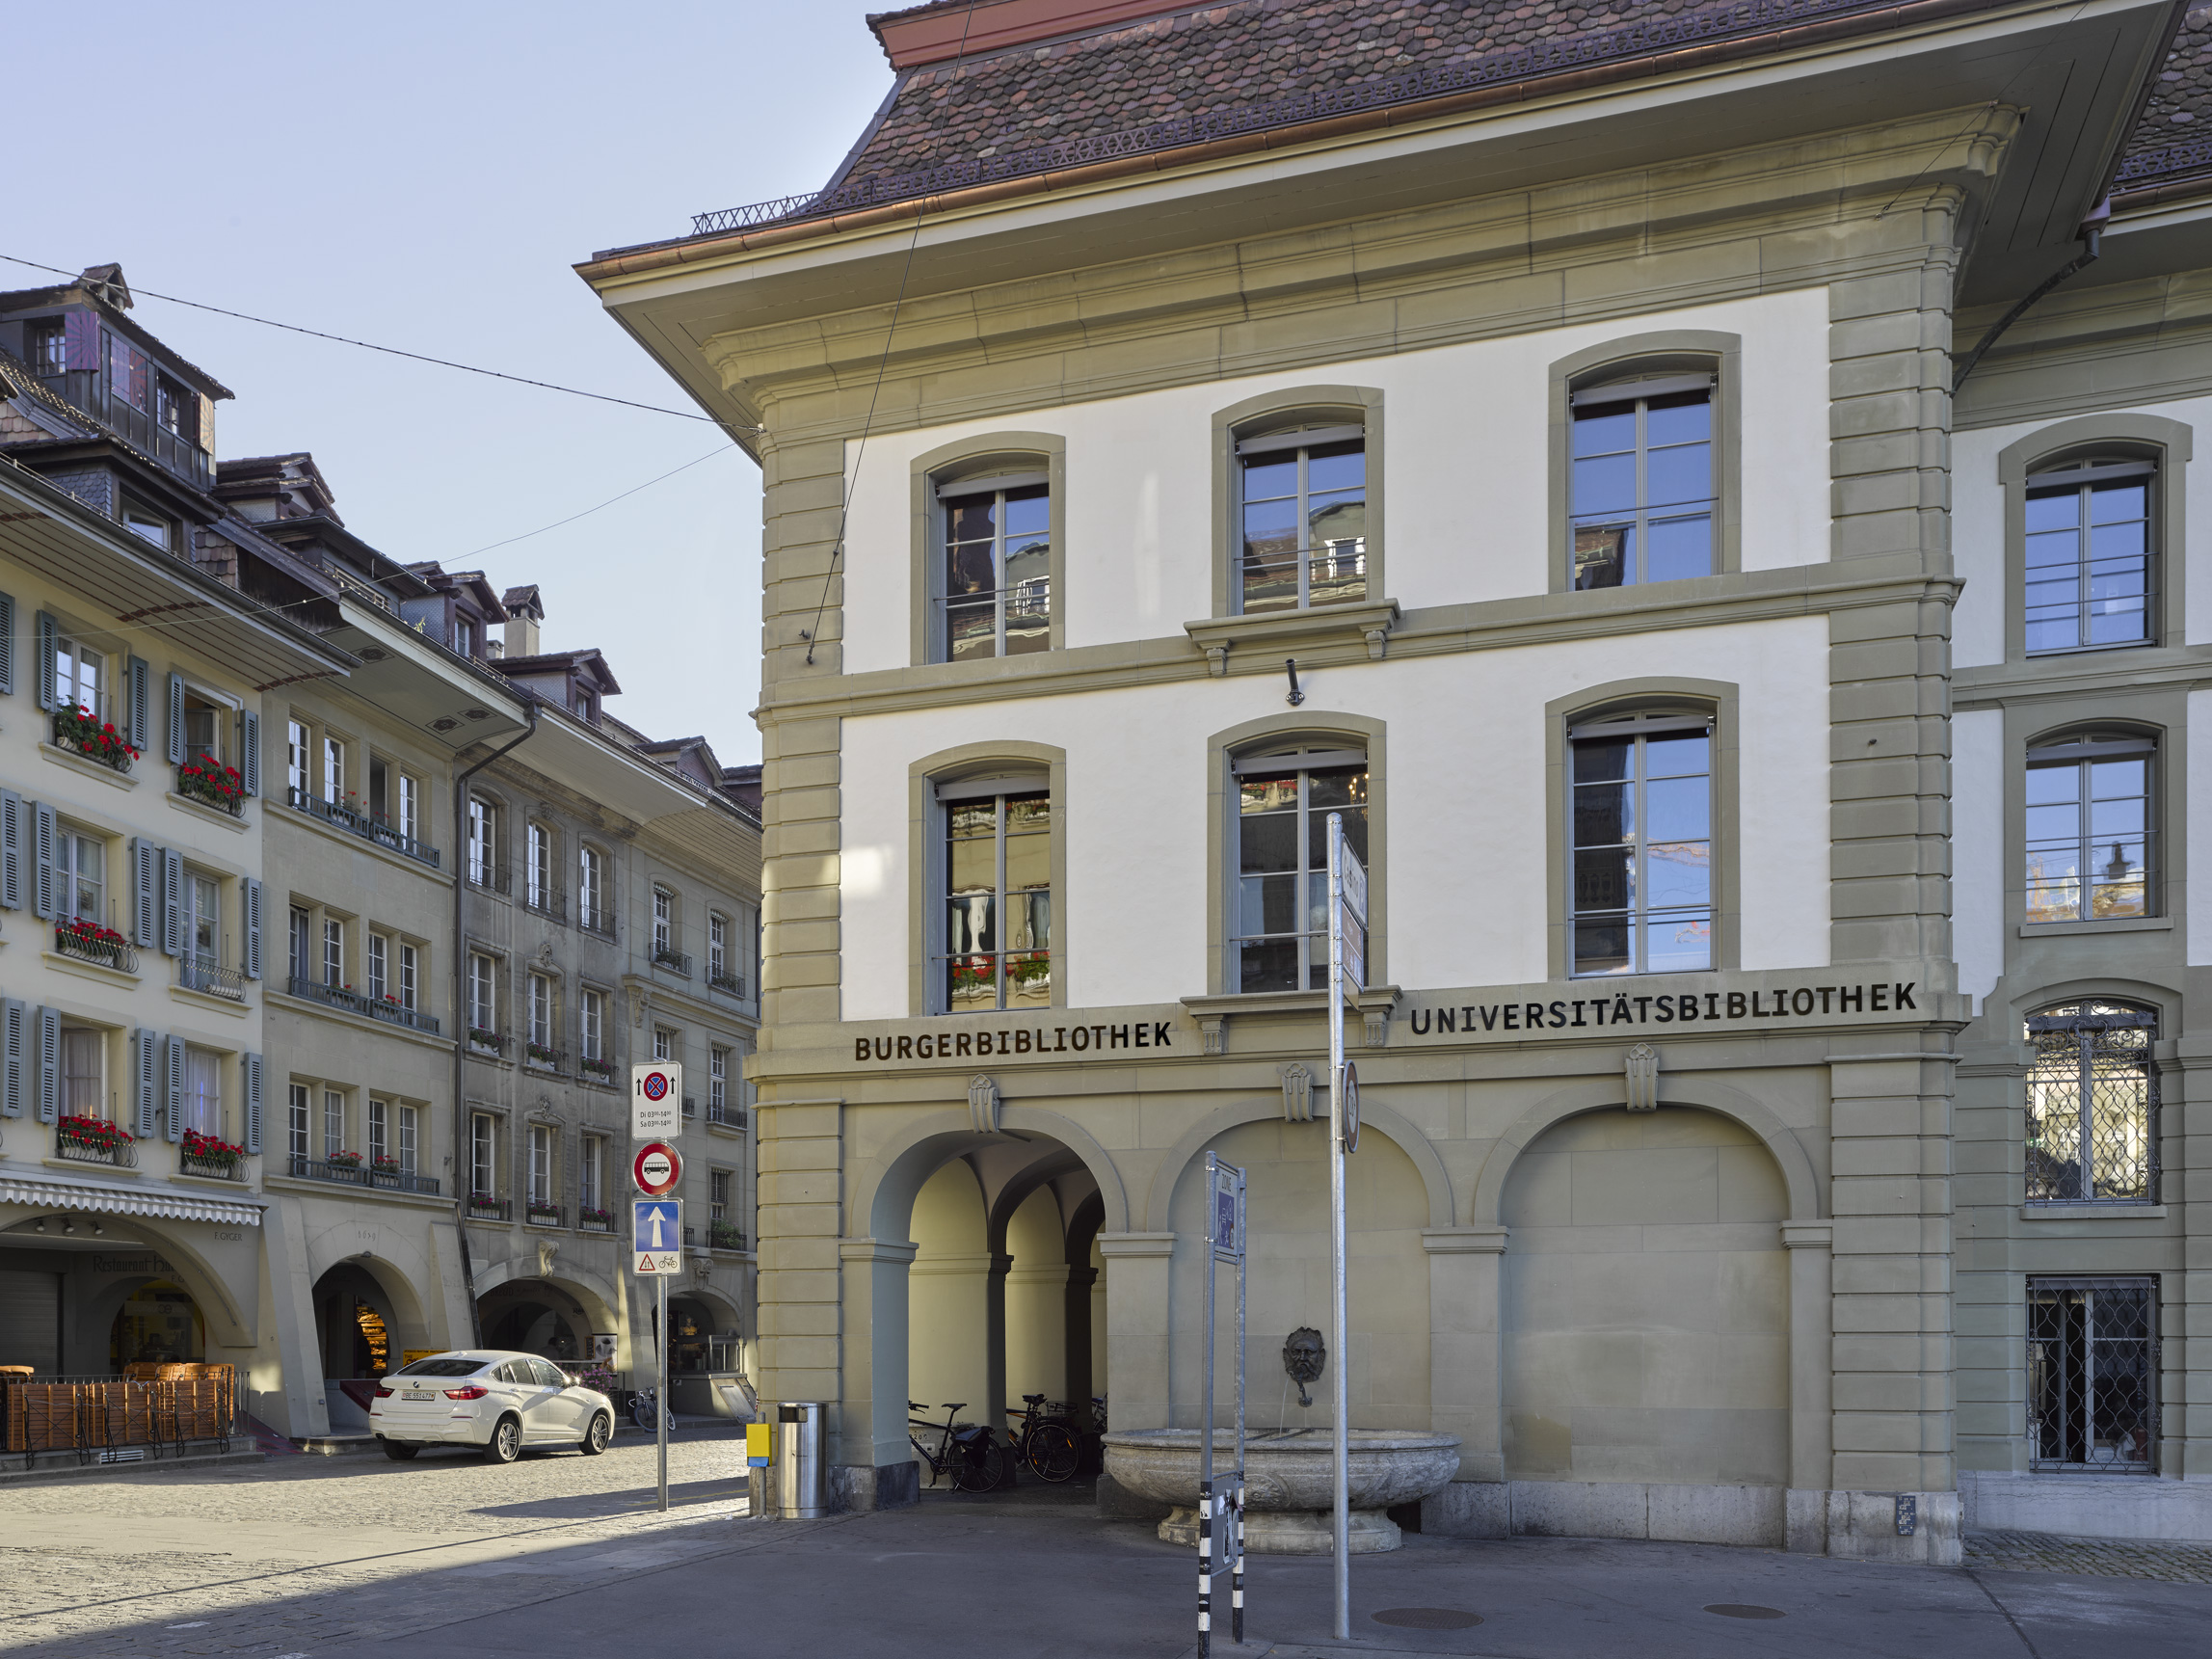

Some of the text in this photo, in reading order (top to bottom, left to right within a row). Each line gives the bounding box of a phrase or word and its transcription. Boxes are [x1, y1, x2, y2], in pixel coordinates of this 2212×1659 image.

[1411, 982, 1917, 1034] UNIVERSITÄTSBIBLIOTHEK
[856, 1022, 1171, 1061] BURGERBIBLIOTHEK
[1222, 1173, 1231, 1191] ZONE
[93, 1255, 151, 1272] Restaurant
